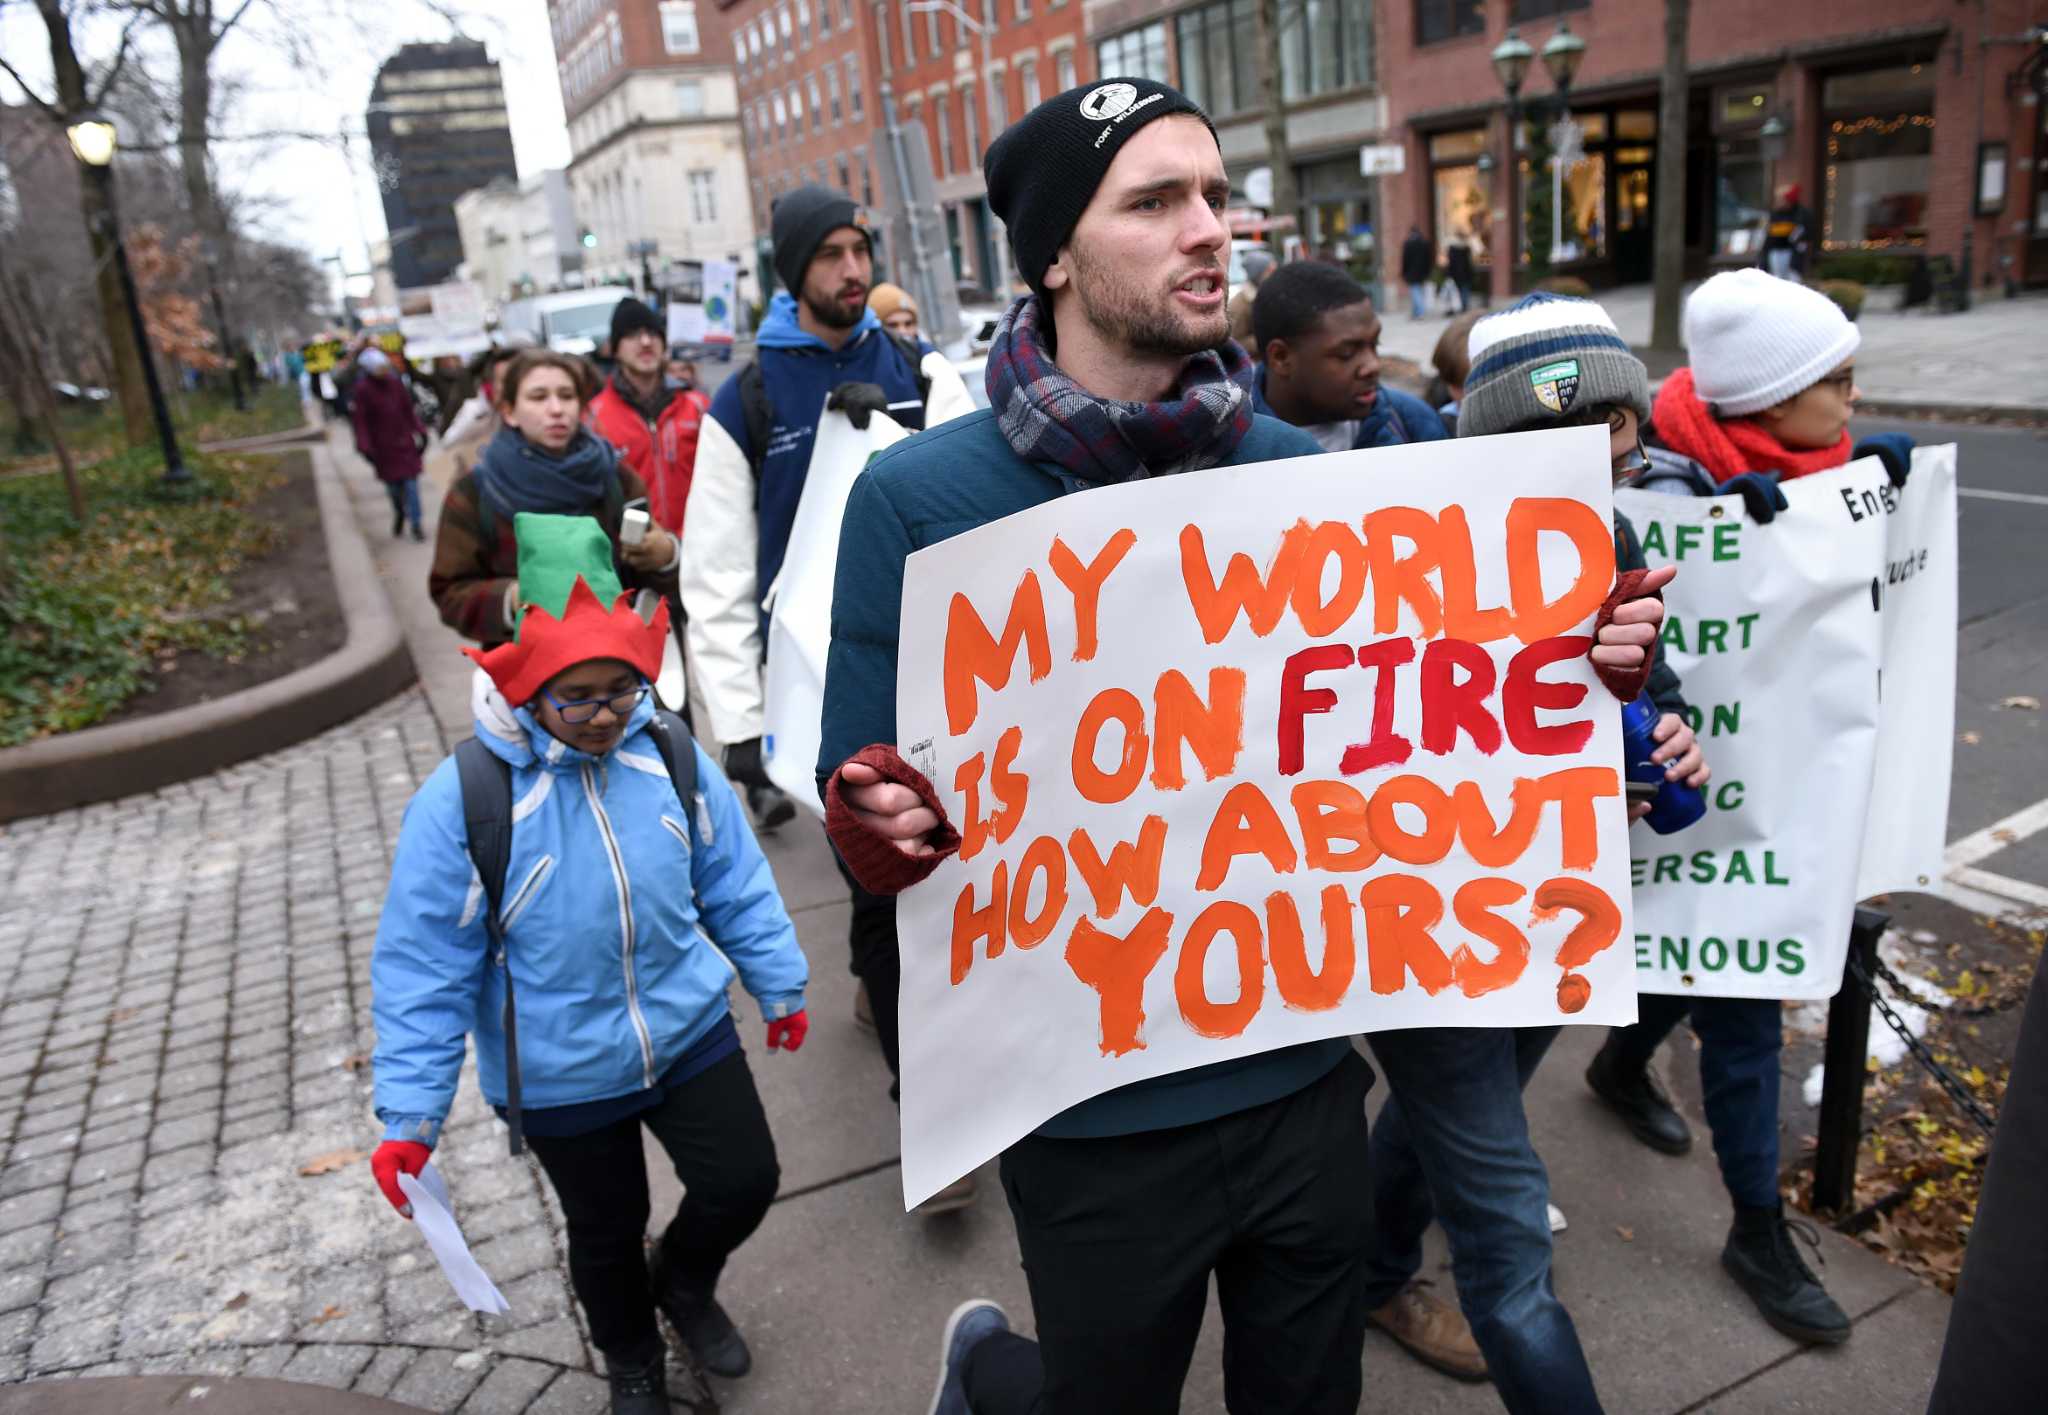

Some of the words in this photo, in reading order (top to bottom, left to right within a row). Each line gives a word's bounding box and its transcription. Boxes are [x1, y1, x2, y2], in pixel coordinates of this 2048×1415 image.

[1094, 124, 1113, 149] FORT
[1839, 484, 1897, 522] Eng
[1641, 519, 1742, 562] AFE
[943, 528, 1138, 737] MY
[1179, 497, 1617, 646] WORLD
[1661, 613, 1760, 655] ART
[1689, 701, 1741, 737] ON
[953, 726, 1029, 862] IS
[1072, 666, 1246, 804] ON
[1277, 635, 1595, 776] FIRE
[950, 814, 1168, 986] HOW
[1195, 766, 1620, 891] ABOUT
[1631, 849, 1790, 886] ERSAL
[1065, 873, 1622, 1058] YOURS?
[1635, 935, 1806, 974] ENOUS
